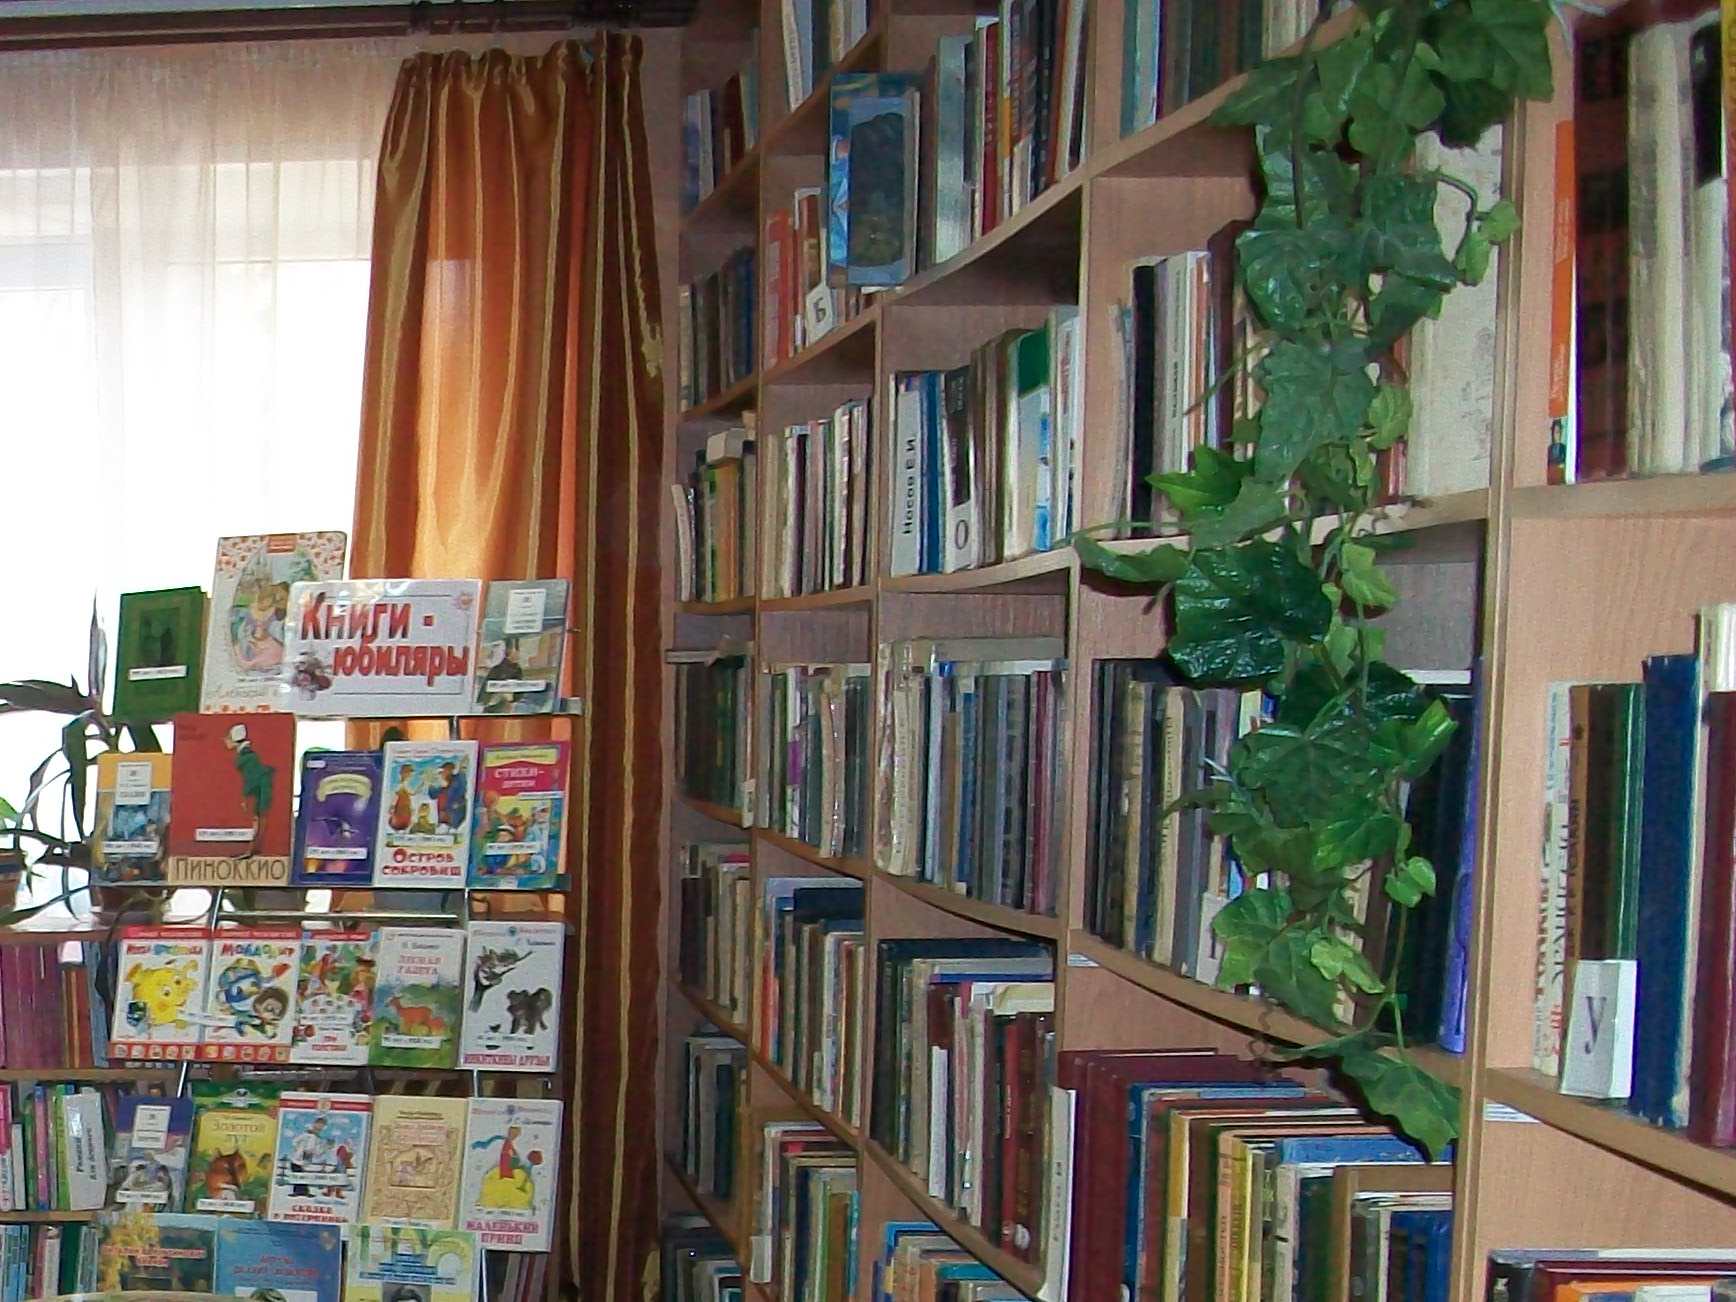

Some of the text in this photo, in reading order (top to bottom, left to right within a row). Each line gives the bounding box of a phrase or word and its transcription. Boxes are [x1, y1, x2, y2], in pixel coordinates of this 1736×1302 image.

[902, 475, 914, 534] Носов
[300, 592, 412, 644] Книги
[332, 645, 470, 687] юбиляры
[175, 858, 286, 881] ПИНОККИО
